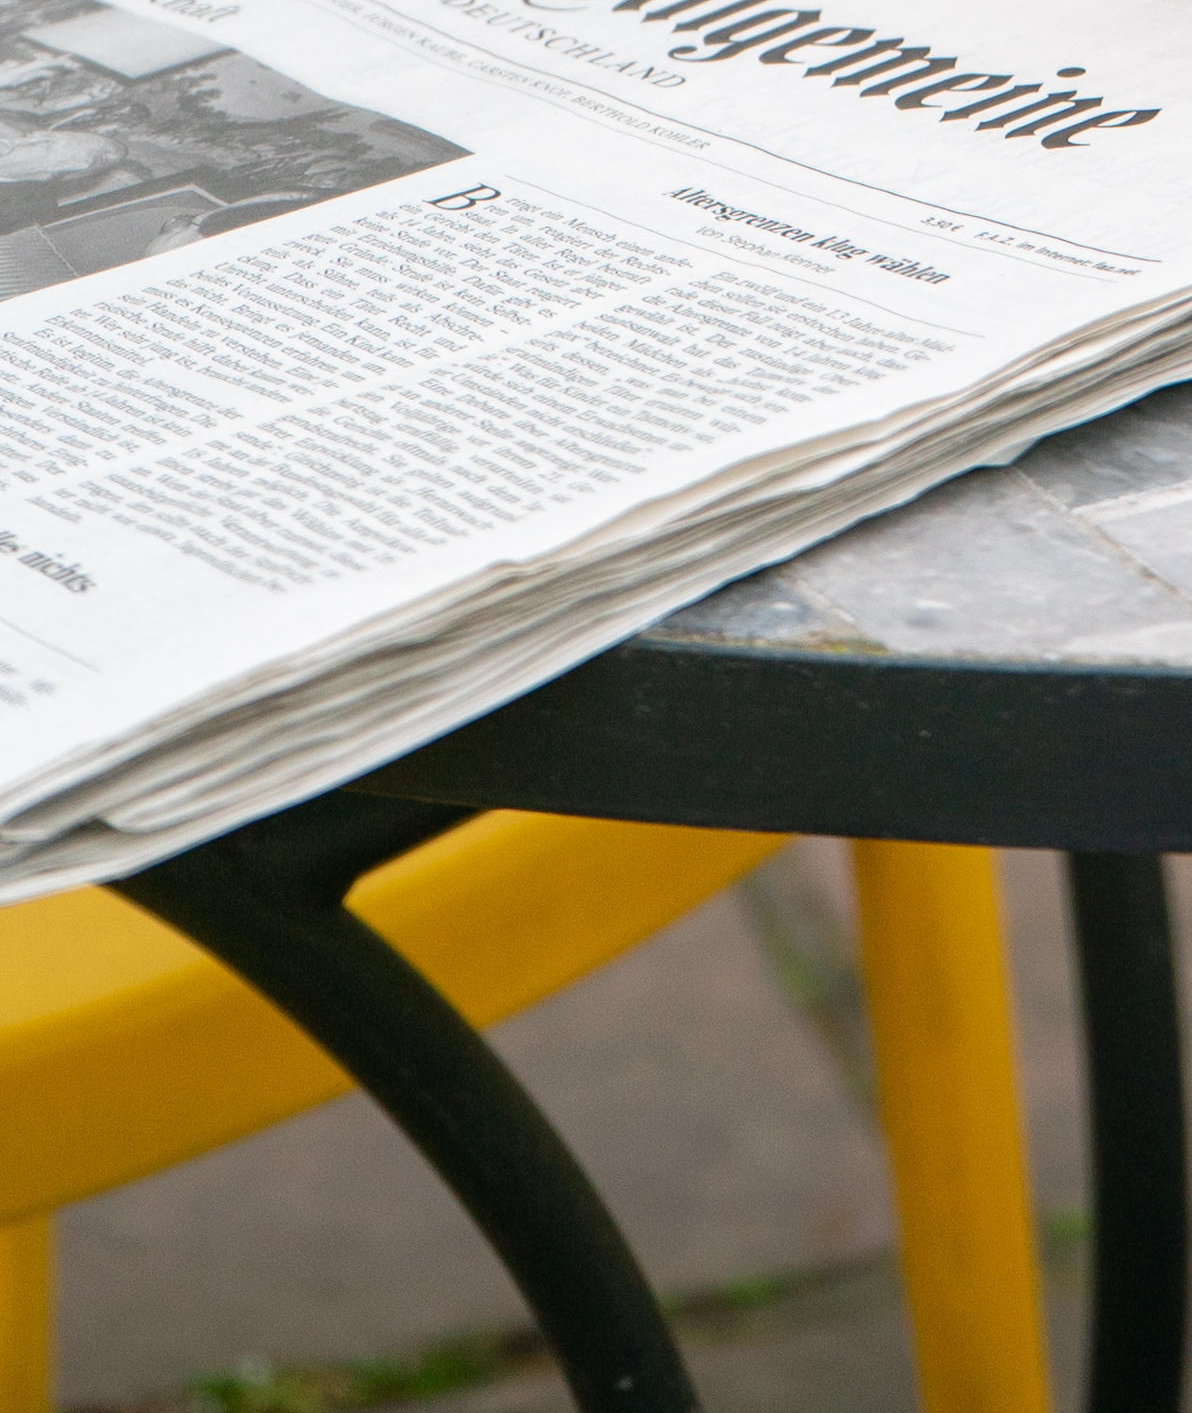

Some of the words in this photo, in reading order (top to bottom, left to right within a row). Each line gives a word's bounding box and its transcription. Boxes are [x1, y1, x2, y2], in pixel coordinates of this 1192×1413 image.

[571, 94, 651, 132] BERTHOLD
[649, 123, 711, 151] KOHLER
[329, 225, 357, 237] mit
[357, 234, 456, 276] Erziehungshilfe.
[461, 275, 505, 296] Dafür
[501, 296, 537, 309] gibt
[352, 216, 390, 233] keine
[390, 230, 431, 248] Strafe
[433, 247, 458, 260] vor.
[459, 258, 490, 272] Der
[488, 270, 527, 288] Staat
[525, 287, 582, 309] reagiert
[375, 210, 399, 221] als
[459, 242, 496, 259] sieht
[495, 258, 522, 269] das
[523, 268, 574, 288] Gesetz
[569, 287, 605, 300] aber
[398, 204, 423, 215] ein
[424, 213, 475, 234] Gericht
[473, 231, 501, 244] den
[502, 242, 541, 262] Täter.
[542, 259, 574, 270] Ist
[577, 273, 628, 292] jünger
[460, 211, 497, 228] staat.
[519, 234, 557, 249] aller
[554, 248, 599, 267] Regel
[596, 263, 652, 285] bestraft
[483, 204, 510, 217] ren
[538, 225, 594, 250] reagiert
[620, 256, 670, 276] Rechts-
[505, 198, 543, 213] ringt
[540, 211, 565, 221] ein
[562, 218, 617, 242] Mensch
[615, 241, 655, 256] einen
[654, 254, 694, 269] ande-
[662, 186, 816, 243] Altersgrenzen
[810, 235, 871, 261] klug
[865, 253, 952, 285] wählen
[695, 225, 725, 241] Von
[728, 233, 781, 259] Stephan
[779, 251, 837, 275] Klenner
[1015, 241, 1036, 251] im
[165, 278, 192, 289] das
[190, 286, 229, 306] nicht.
[230, 304, 276, 324] Bringt
[288, 331, 360, 364] jemanden
[189, 269, 233, 287] beides
[232, 284, 320, 327] Voraussetzung.
[319, 322, 348, 339] Ein
[344, 335, 386, 354] Kind
[377, 350, 415, 369] kann
[214, 261, 268, 285] Unrecht
[266, 283, 354, 321] unterscheiden
[393, 338, 417, 350] ist
[414, 347, 440, 360] für
[236, 256, 278, 272] ckung.
[282, 271, 318, 289] Dass
[320, 289, 345, 300] ein
[349, 298, 387, 316] Täter
[388, 315, 432, 337] Recht
[433, 337, 468, 352] und
[260, 247, 291, 260] teils
[291, 259, 316, 270] als
[366, 288, 397, 303] teils
[398, 302, 423, 314] als
[424, 313, 484, 342] Abschre-
[301, 233, 338, 245] gute
[338, 242, 393, 266] Gründe:
[392, 264, 434, 283] Strafe
[432, 280, 455, 291] ist
[452, 288, 486, 307] kein
[485, 304, 531, 326] Selbst-
[329, 256, 354, 268] Sie
[354, 267, 392, 284] muss
[395, 283, 440, 304] wirken
[441, 302, 494, 327] können
[17, 551, 97, 594] nichts
